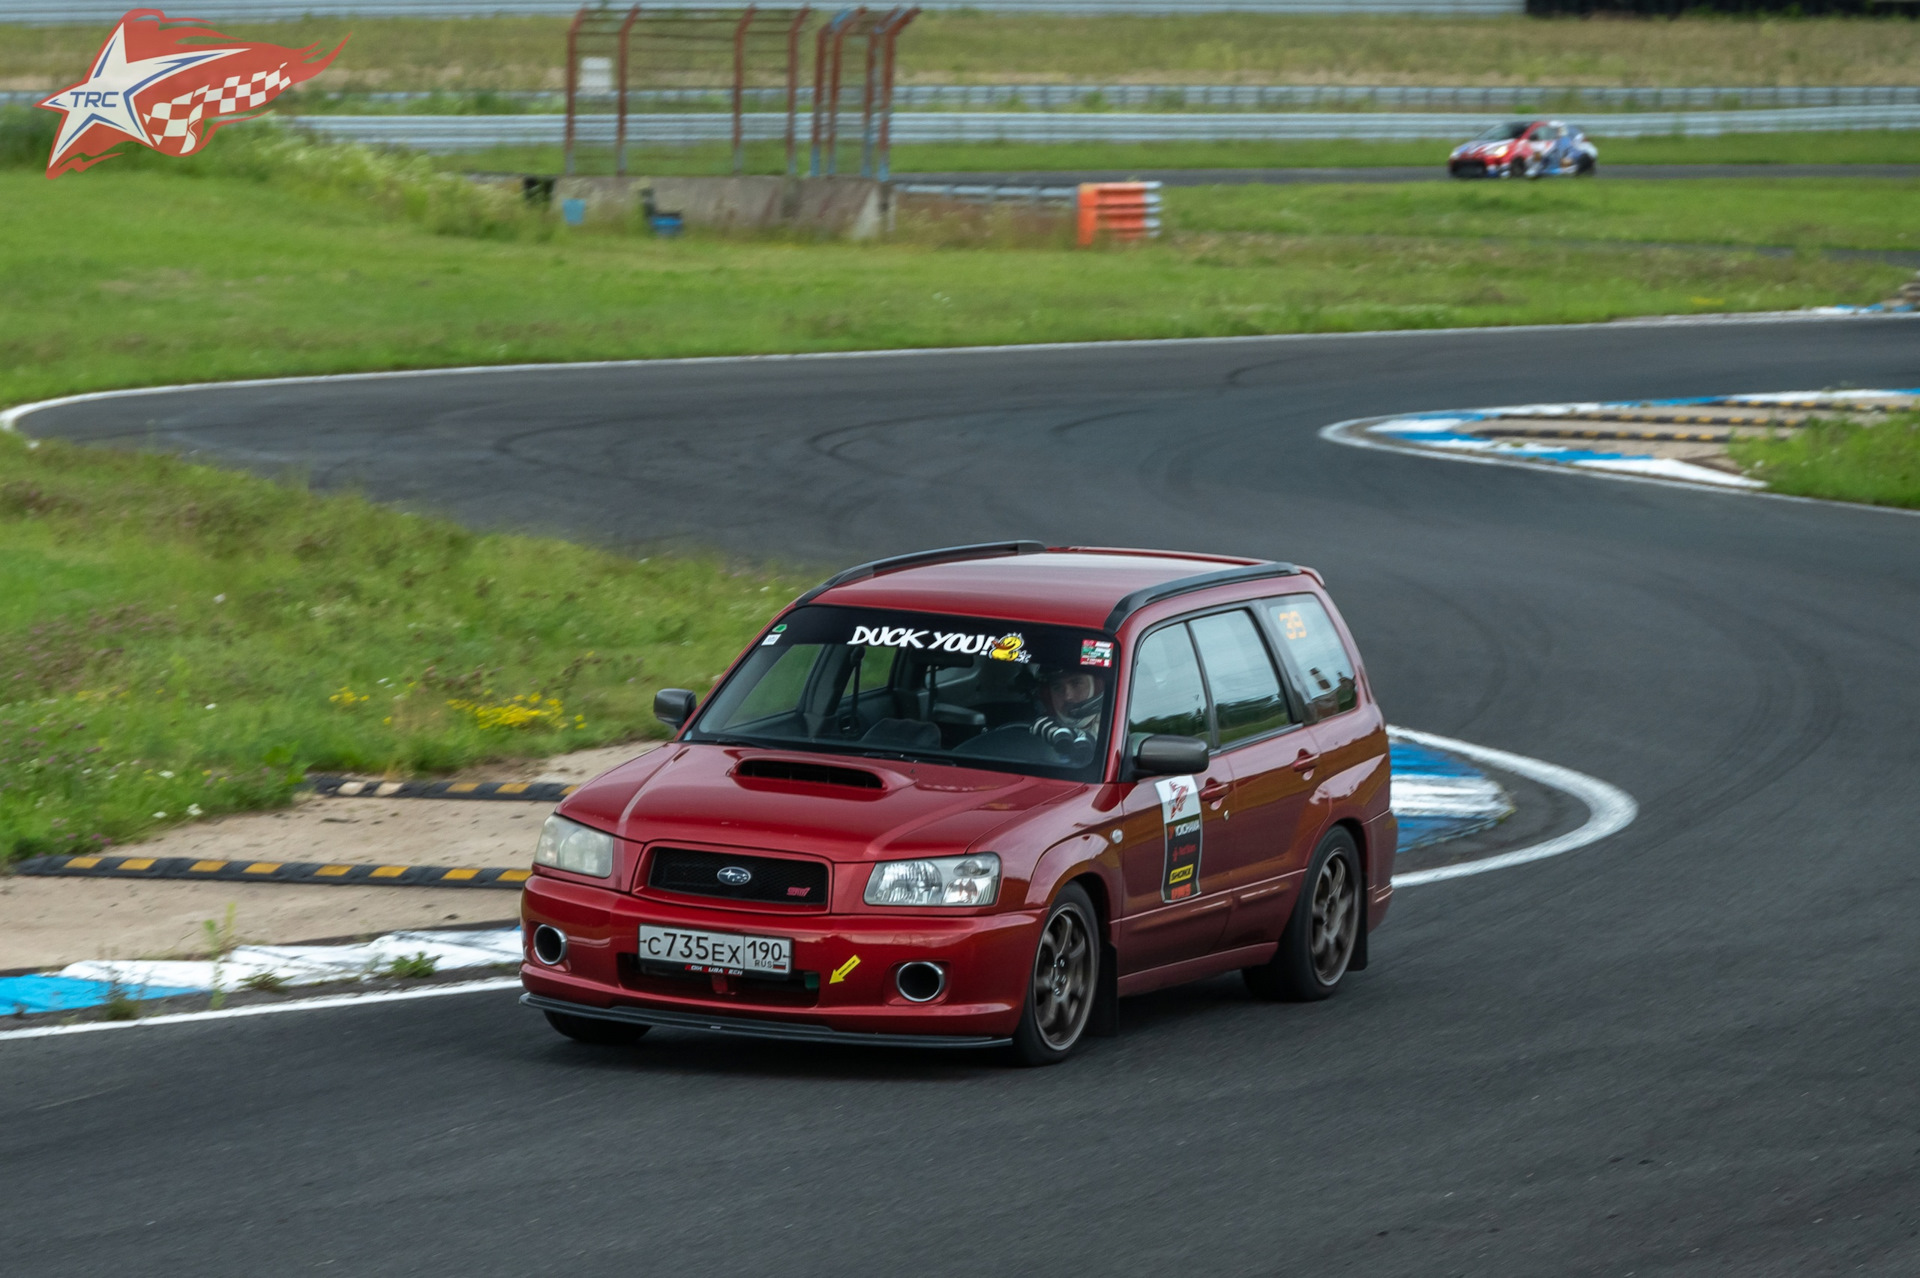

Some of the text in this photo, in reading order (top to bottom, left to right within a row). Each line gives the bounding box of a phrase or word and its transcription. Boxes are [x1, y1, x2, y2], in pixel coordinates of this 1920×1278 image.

[847, 625, 930, 649] DUCK
[927, 631, 996, 656] YOU!
[747, 940, 783, 962] 190
[754, 959, 773, 969] RUS
